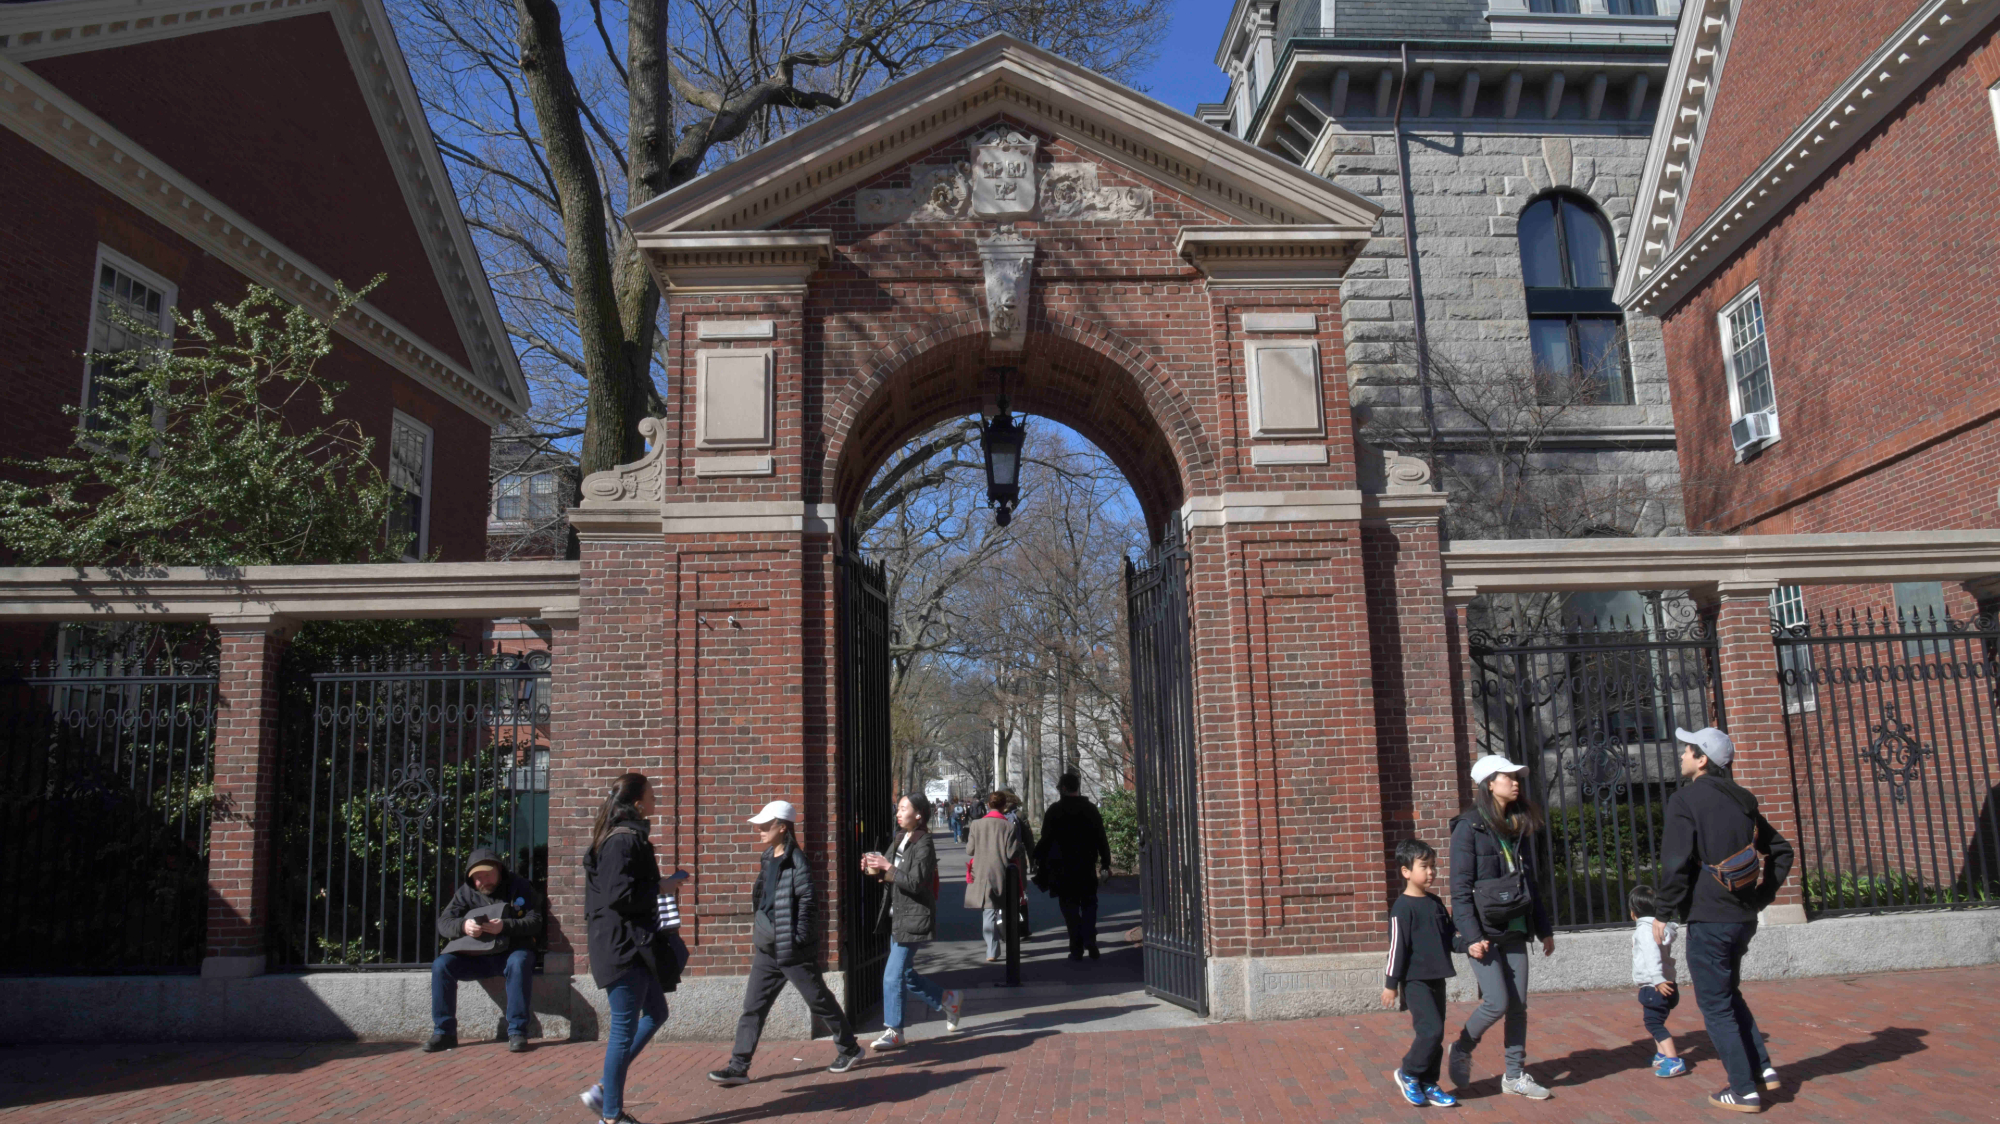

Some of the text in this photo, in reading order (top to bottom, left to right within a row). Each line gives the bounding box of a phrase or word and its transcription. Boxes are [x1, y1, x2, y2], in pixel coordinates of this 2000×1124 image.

[1268, 970, 1380, 990] BUILT IN 1901
